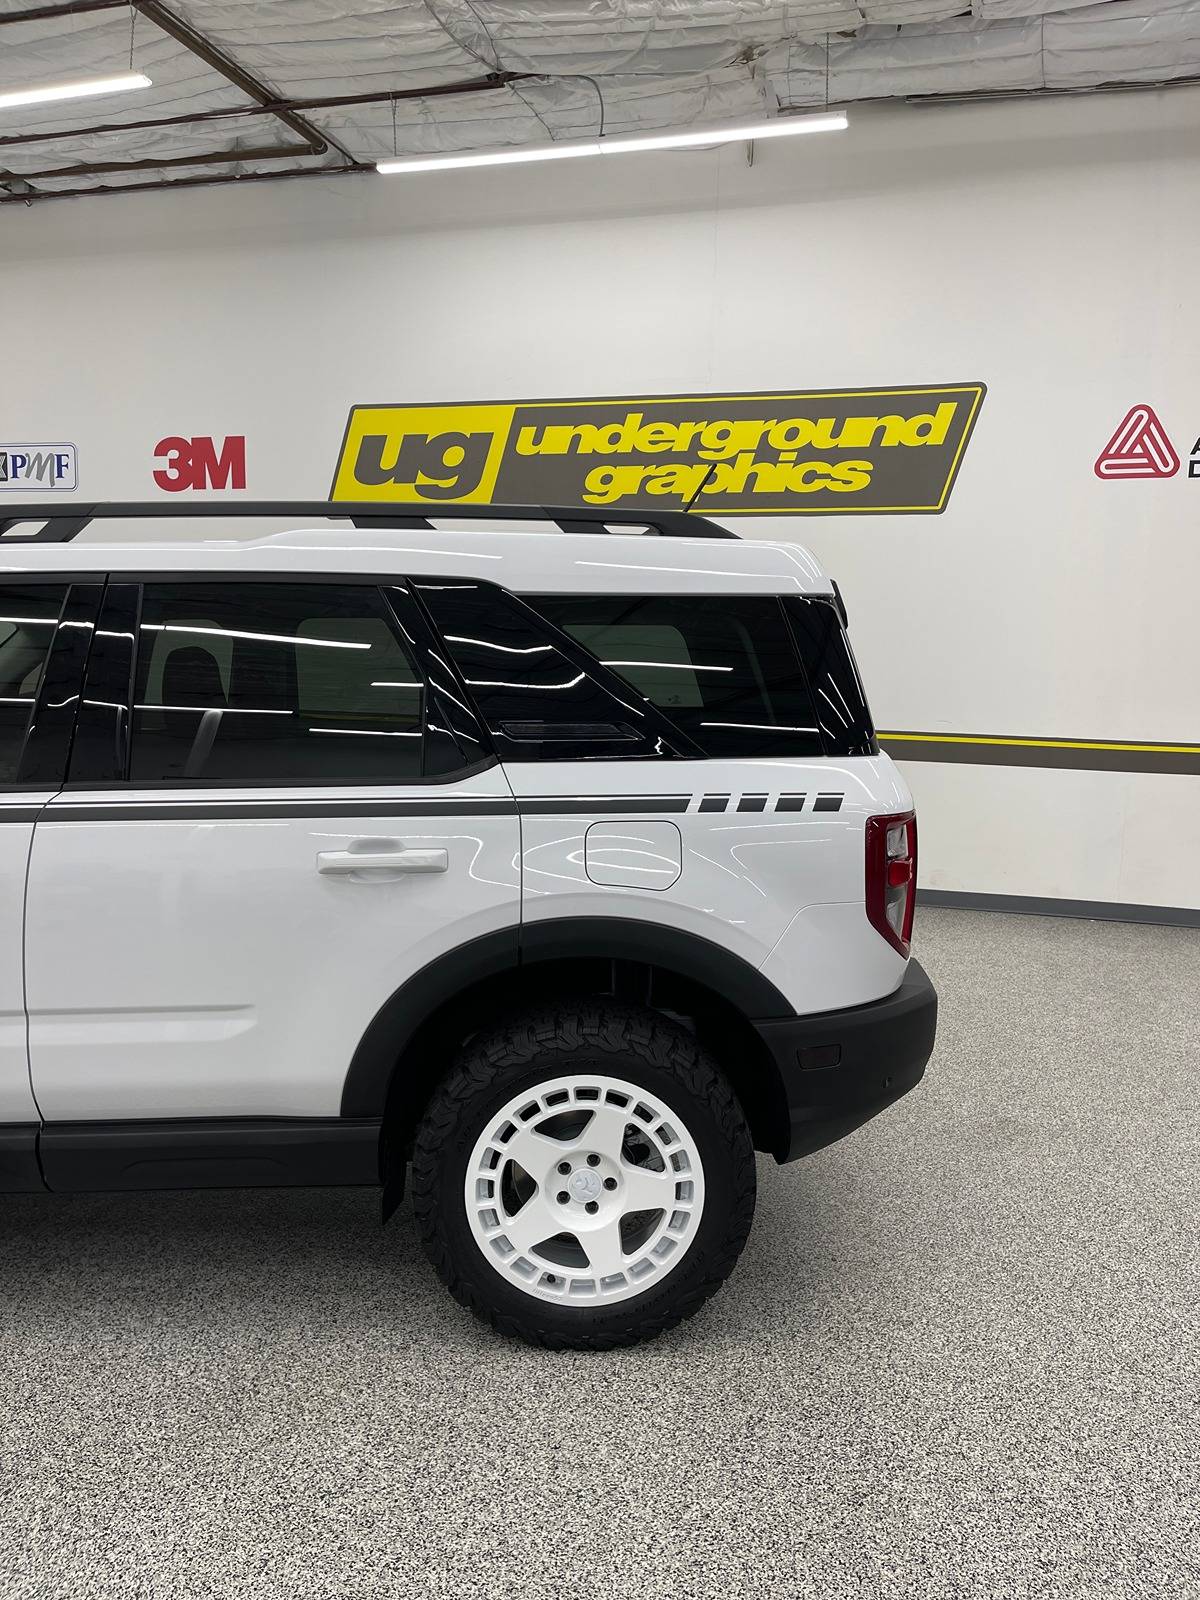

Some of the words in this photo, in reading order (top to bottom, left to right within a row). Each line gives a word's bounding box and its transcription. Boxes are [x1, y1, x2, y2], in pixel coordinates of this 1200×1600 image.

[515, 402, 958, 461] underground
[153, 436, 246, 492] 3M
[354, 432, 494, 500] ug
[582, 452, 874, 504] graphics
